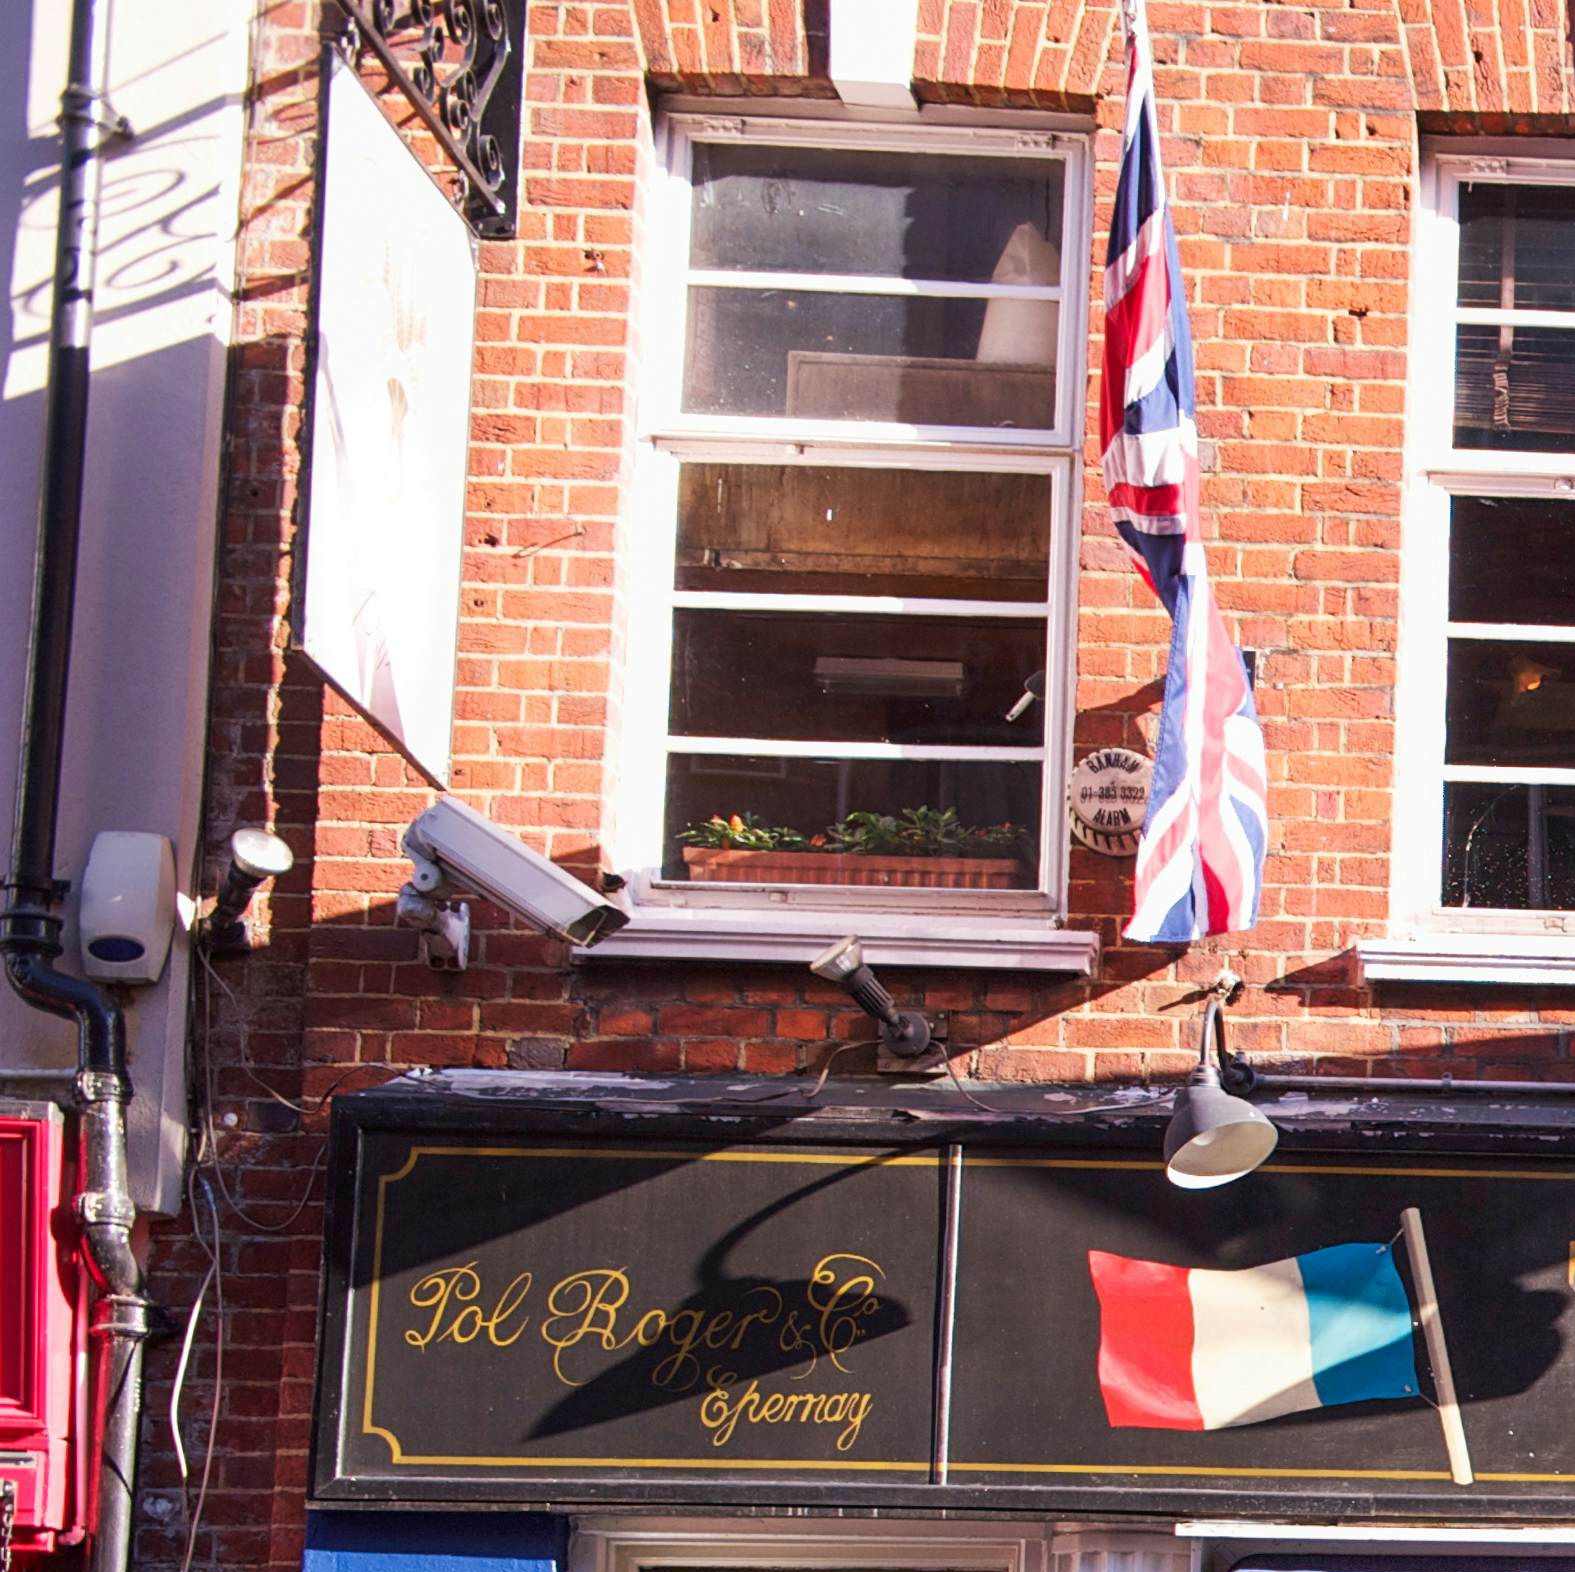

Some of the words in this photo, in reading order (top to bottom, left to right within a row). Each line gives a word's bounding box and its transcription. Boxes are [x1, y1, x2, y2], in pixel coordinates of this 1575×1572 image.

[1086, 753, 1140, 774] BANHAM
[1092, 807, 1132, 826] ALARM
[405, 1261, 533, 1354] Pol
[542, 1266, 782, 1391] Roger
[700, 1365, 873, 1451] Epernay
